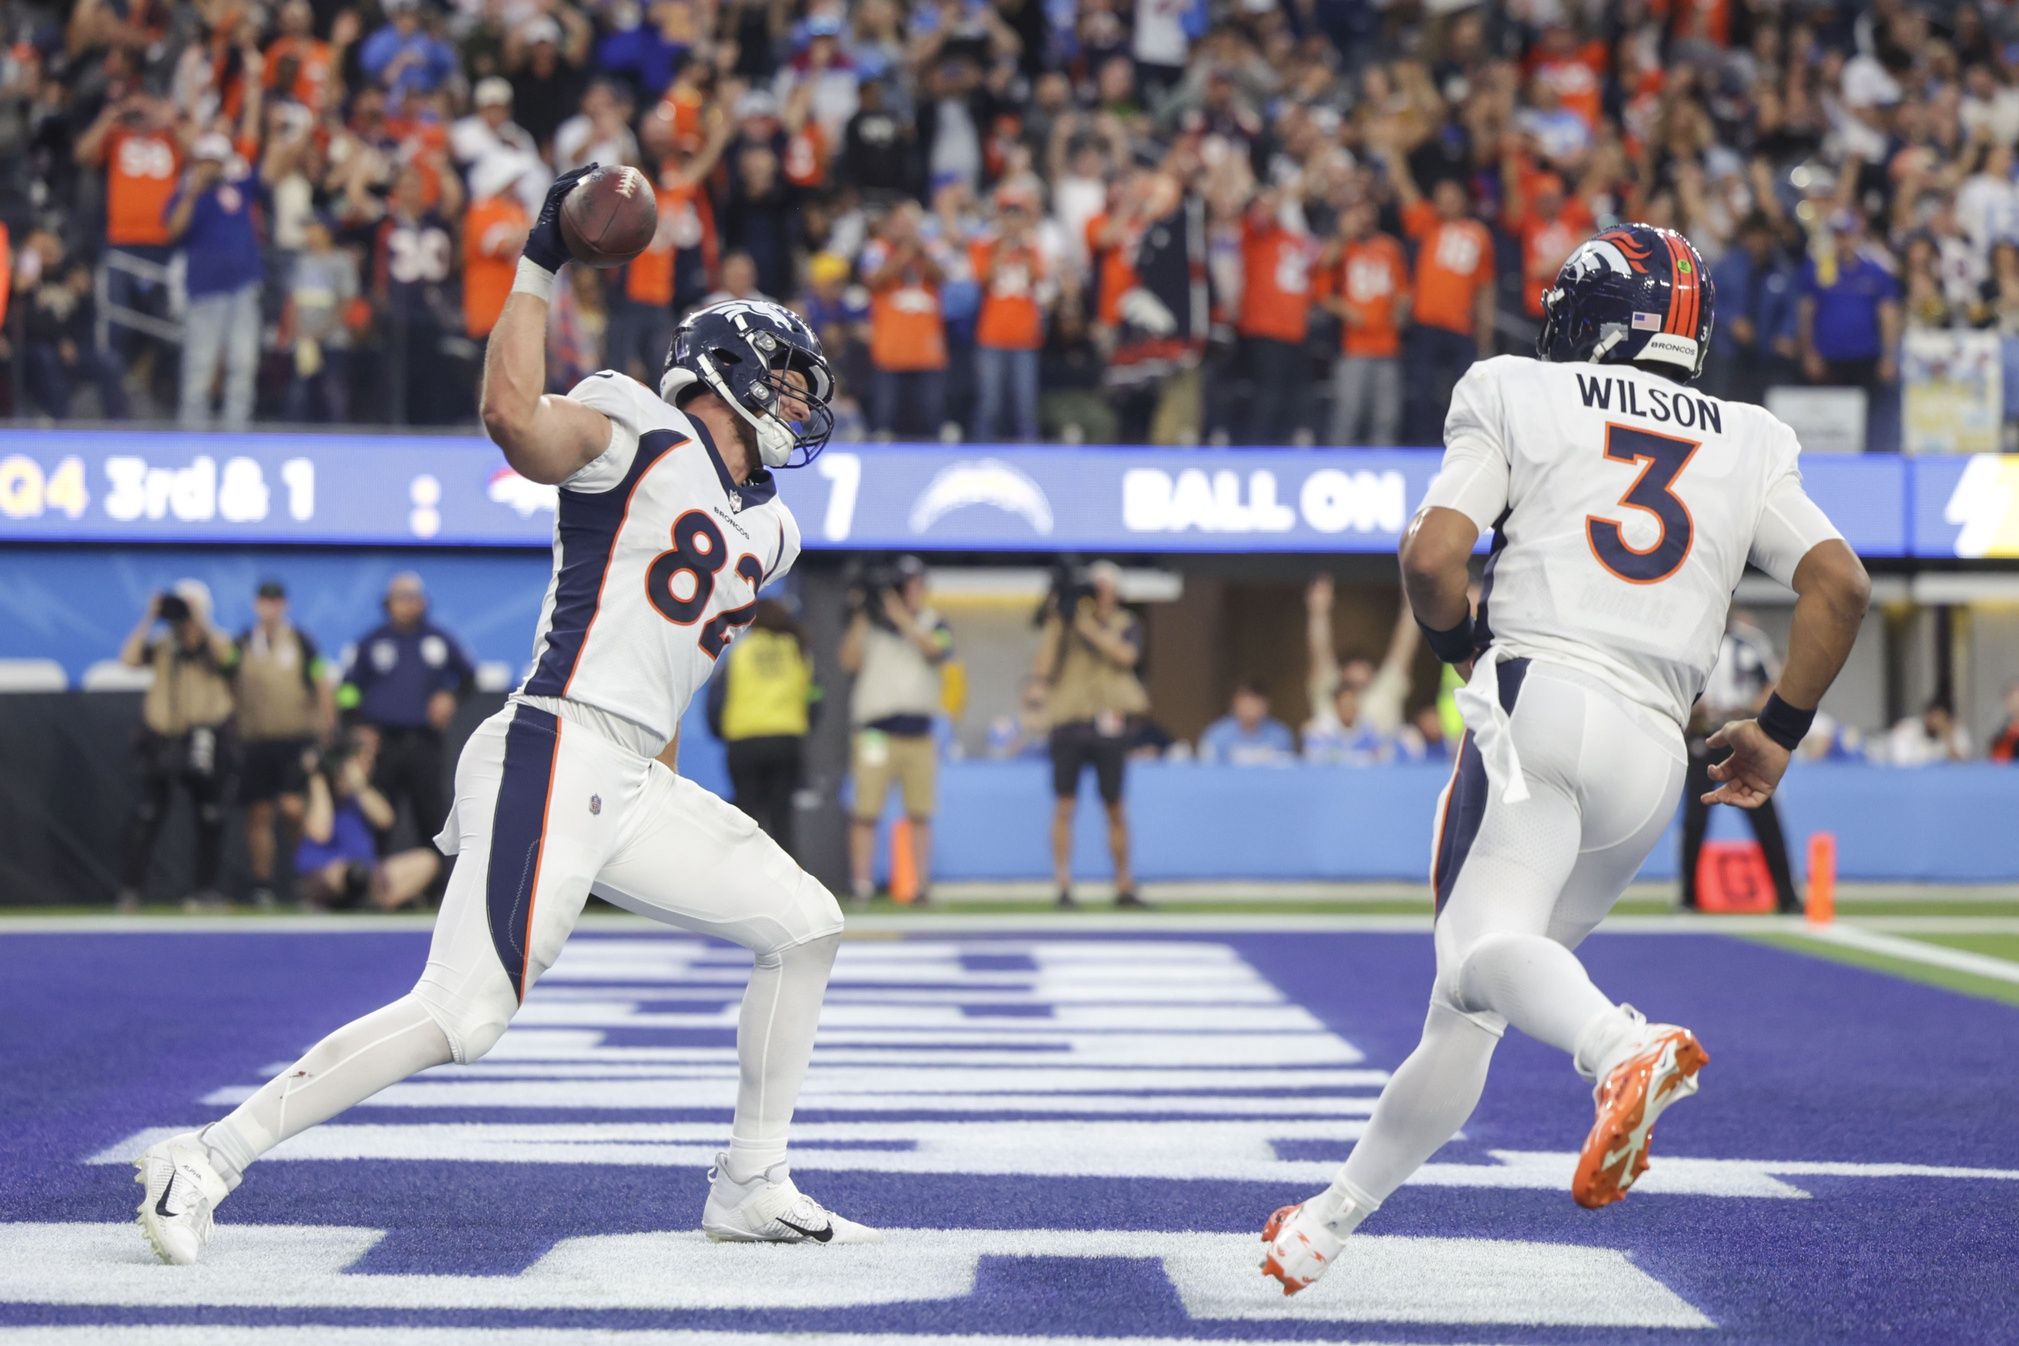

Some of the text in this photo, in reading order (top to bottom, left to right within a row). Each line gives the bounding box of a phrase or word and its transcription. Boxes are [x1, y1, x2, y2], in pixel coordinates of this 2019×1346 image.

[1650, 341, 1696, 356] BRONCOS
[1575, 373, 1723, 435] WILSON
[0, 454, 90, 521] Q4
[281, 456, 315, 522] 1
[1122, 467, 1407, 534] BALL ON
[1585, 420, 1703, 586] 3
[713, 506, 750, 540] BRONCOS
[645, 508, 764, 662] 82
[1715, 851, 1758, 902] G
